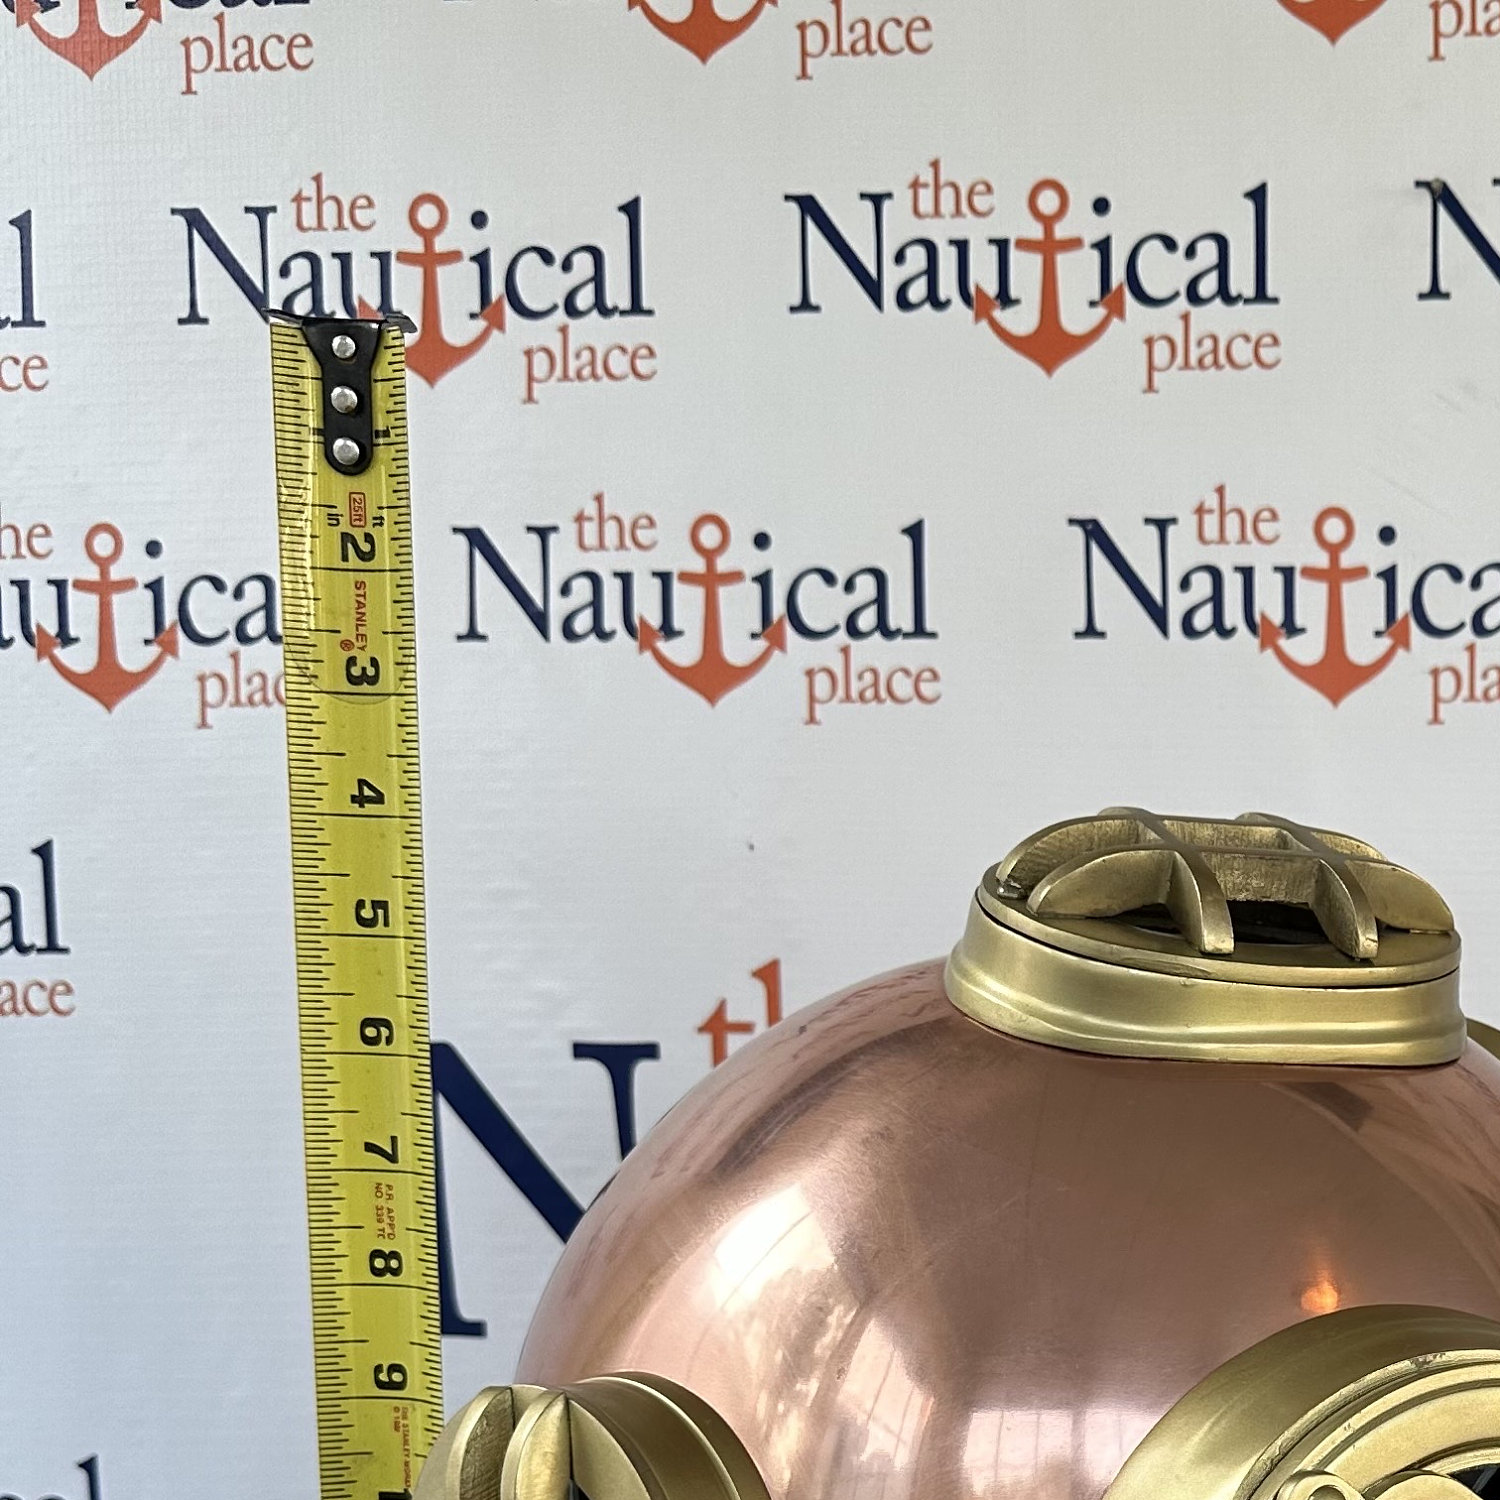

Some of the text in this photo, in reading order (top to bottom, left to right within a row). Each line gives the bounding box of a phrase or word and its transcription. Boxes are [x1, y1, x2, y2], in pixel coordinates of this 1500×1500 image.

[180, 11, 313, 95] place
[794, 0, 933, 81] place
[291, 172, 376, 233] the
[907, 157, 995, 220] the
[171, 196, 654, 390] Nautical
[784, 182, 1278, 378] Nautical
[523, 322, 657, 405] place
[1143, 309, 1282, 396] place
[572, 491, 657, 553] the
[1192, 483, 1281, 547] the
[340, 531, 376, 563] 2
[354, 580, 368, 653] STANLEY
[452, 520, 937, 707] Nautical
[346, 655, 381, 686] 3
[803, 643, 941, 727] place
[350, 777, 386, 809] 4
[355, 898, 390, 929] 5
[360, 1016, 394, 1047] 6
[364, 1134, 400, 1164] 7
[369, 1249, 403, 1278] 8
[373, 1363, 408, 1391] 9
